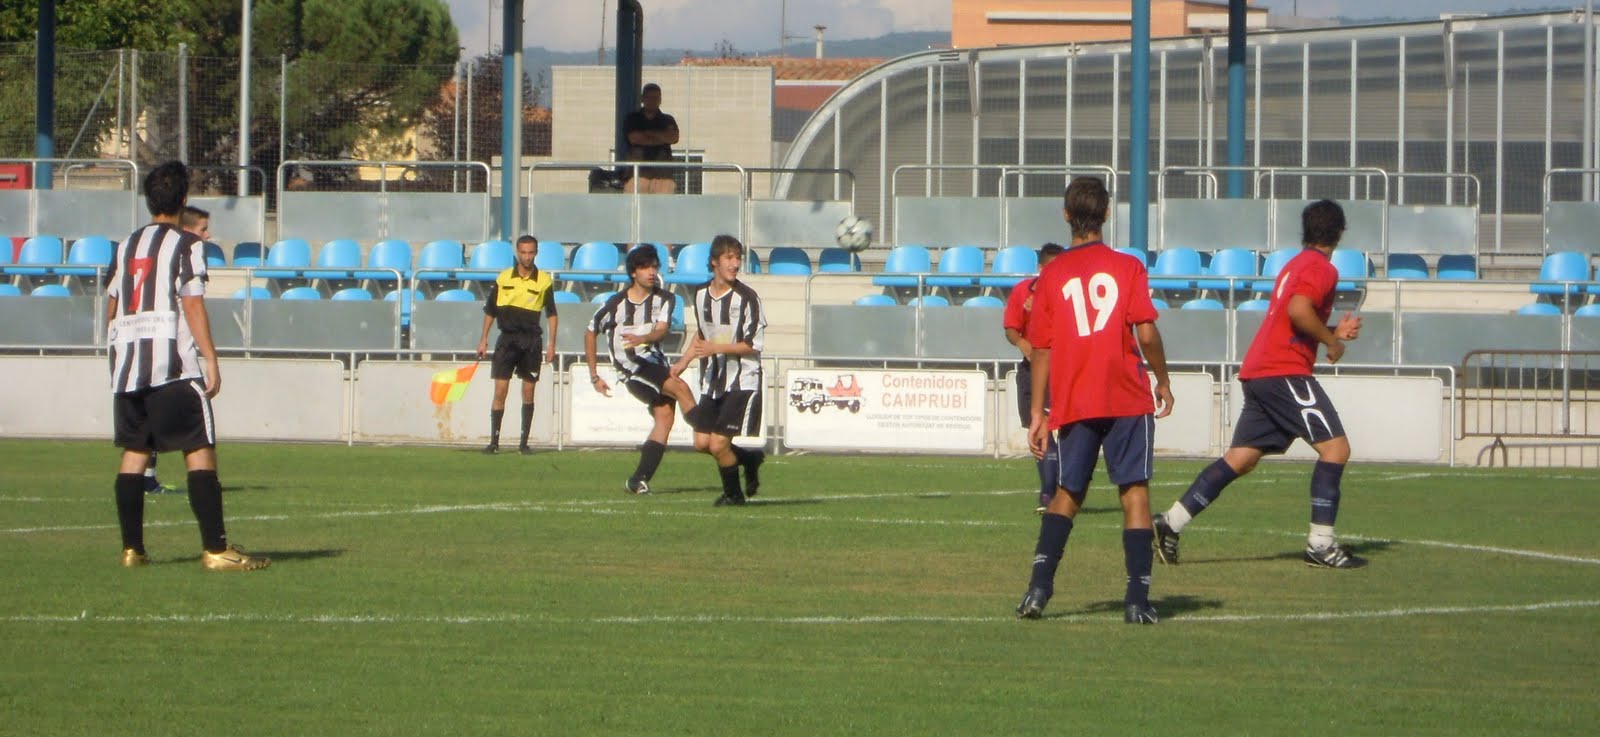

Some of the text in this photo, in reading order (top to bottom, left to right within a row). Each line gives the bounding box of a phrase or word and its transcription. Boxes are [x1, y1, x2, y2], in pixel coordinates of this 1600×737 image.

[128, 257, 153, 312] 7
[1062, 272, 1118, 336] 19
[881, 373, 968, 390] Contenidors
[881, 391, 967, 409] CAMPRUBÍ
